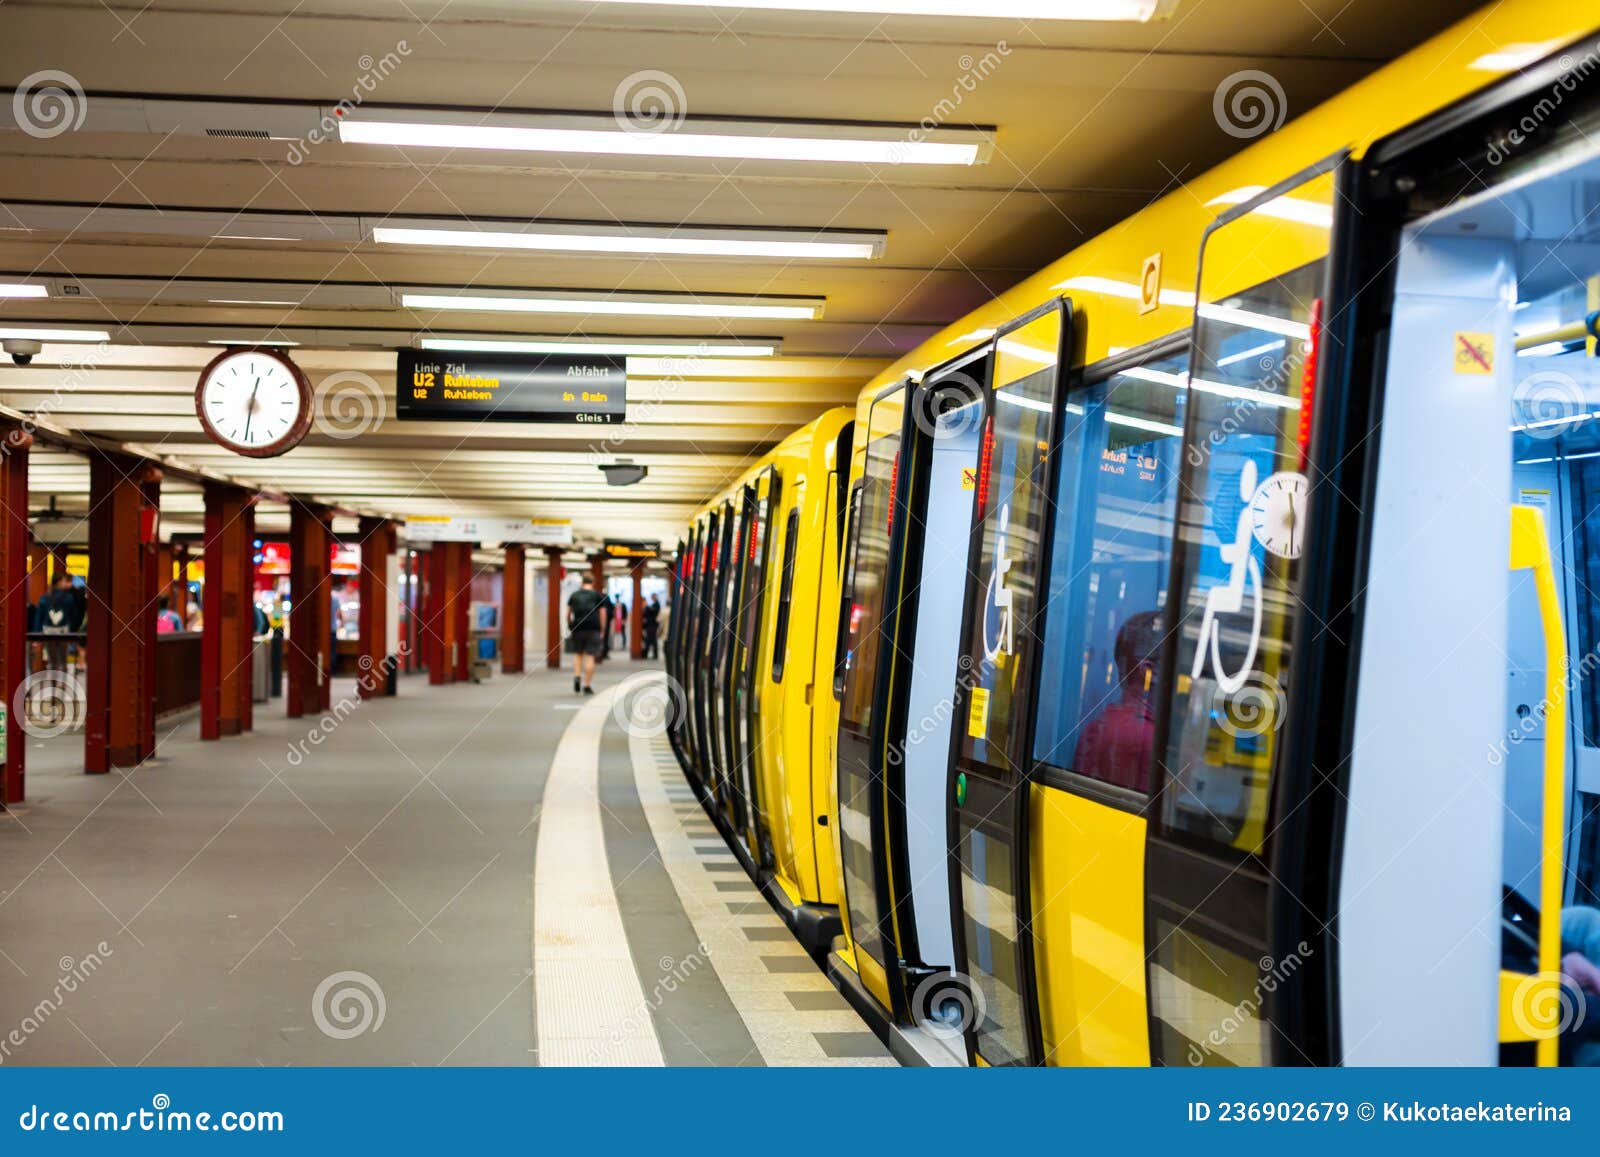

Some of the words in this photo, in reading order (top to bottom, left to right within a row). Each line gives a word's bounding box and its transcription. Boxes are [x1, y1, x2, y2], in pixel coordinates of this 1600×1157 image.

[414, 363, 440, 374] Linie
[446, 363, 465, 374] Ziel
[567, 366, 609, 377] Abfahrt
[413, 373, 435, 387] U2
[444, 374, 499, 388] Ruhleben
[413, 388, 428, 399] U2
[444, 389, 492, 400] Ruhleben
[562, 391, 575, 402] in
[575, 413, 602, 423] Gleis
[605, 414, 611, 423] 1
